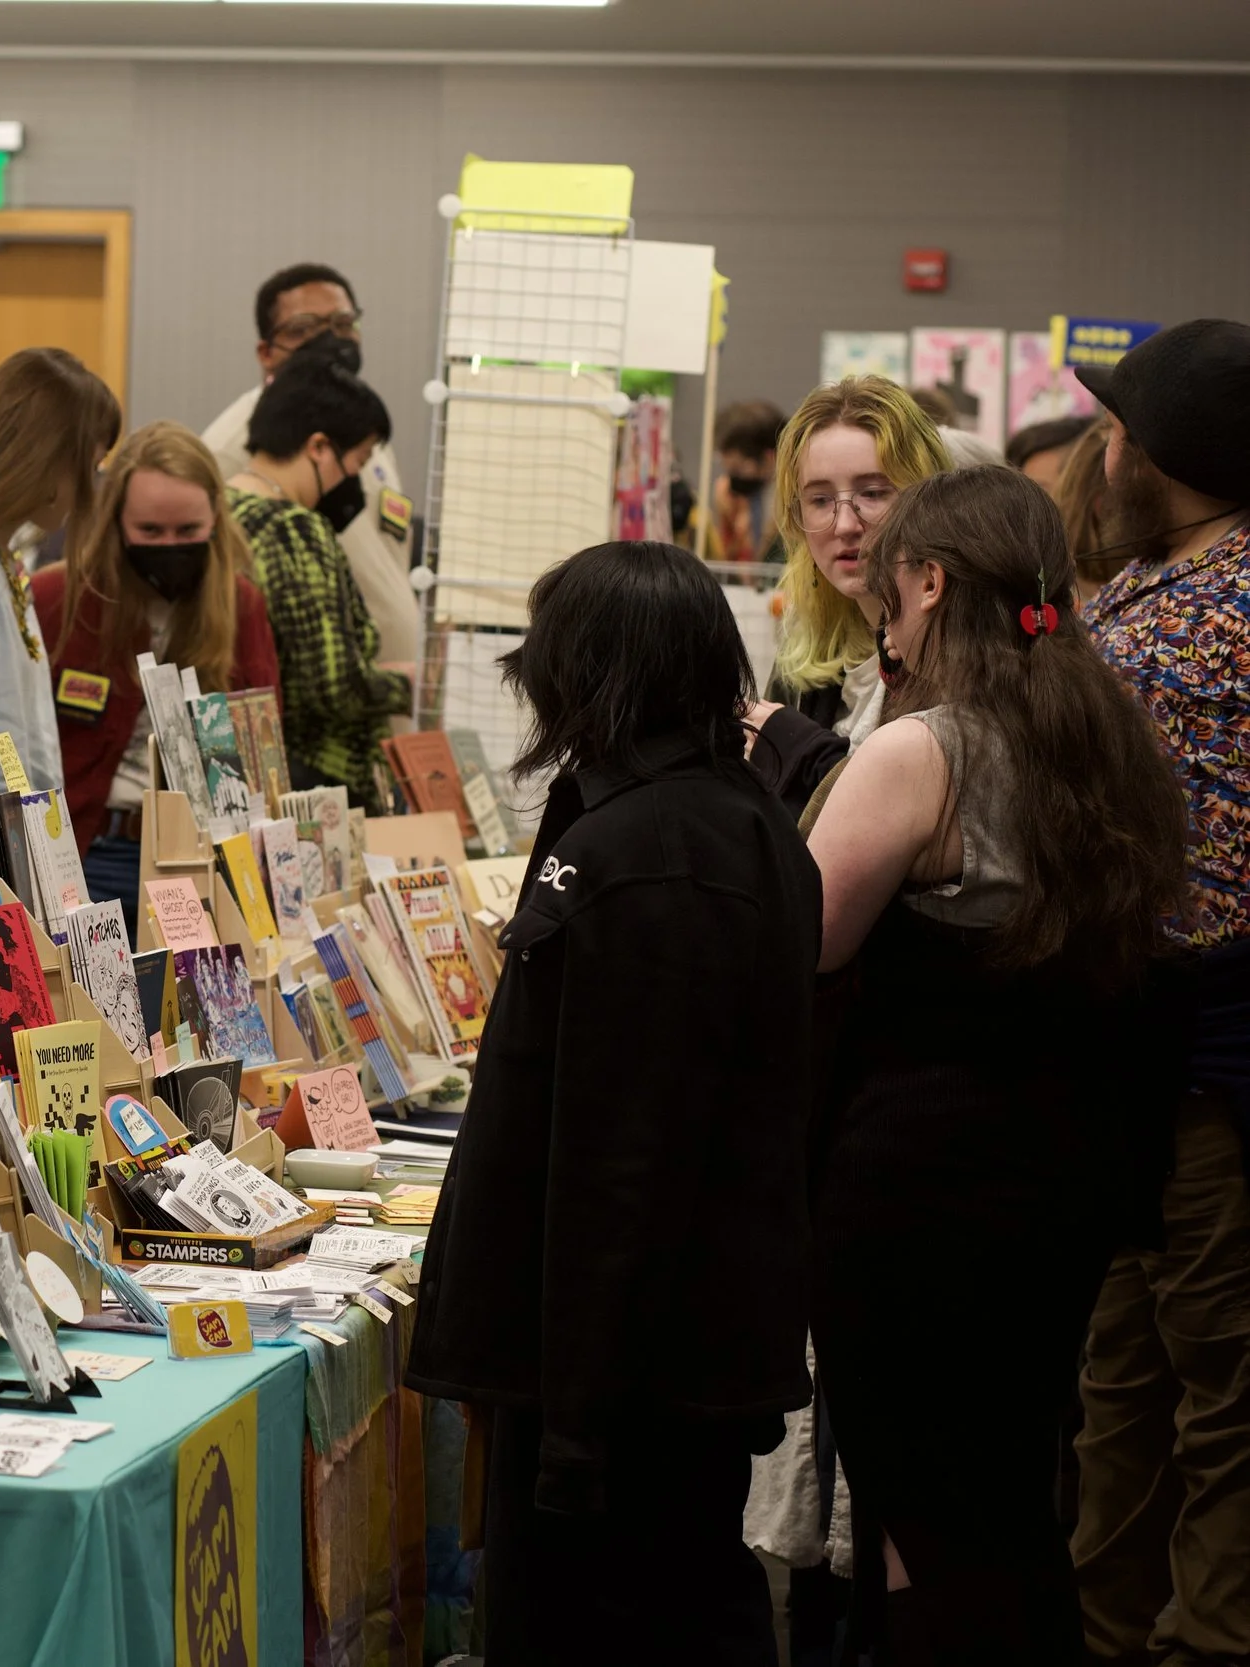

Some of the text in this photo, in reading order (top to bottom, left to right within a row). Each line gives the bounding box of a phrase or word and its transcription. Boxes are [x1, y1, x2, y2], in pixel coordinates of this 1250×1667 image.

[153, 887, 186, 903] VIVIAN'S
[161, 901, 184, 915] GHOST
[36, 1042, 95, 1066] YOU NEED MORE
[195, 1187, 210, 1207] KPOP
[204, 1175, 220, 1196] SONGS
[145, 1243, 228, 1263] STAMPERS
[202, 1317, 222, 1337] YAM
[191, 1503, 230, 1641] YAM
[200, 1570, 238, 1667] FAM
